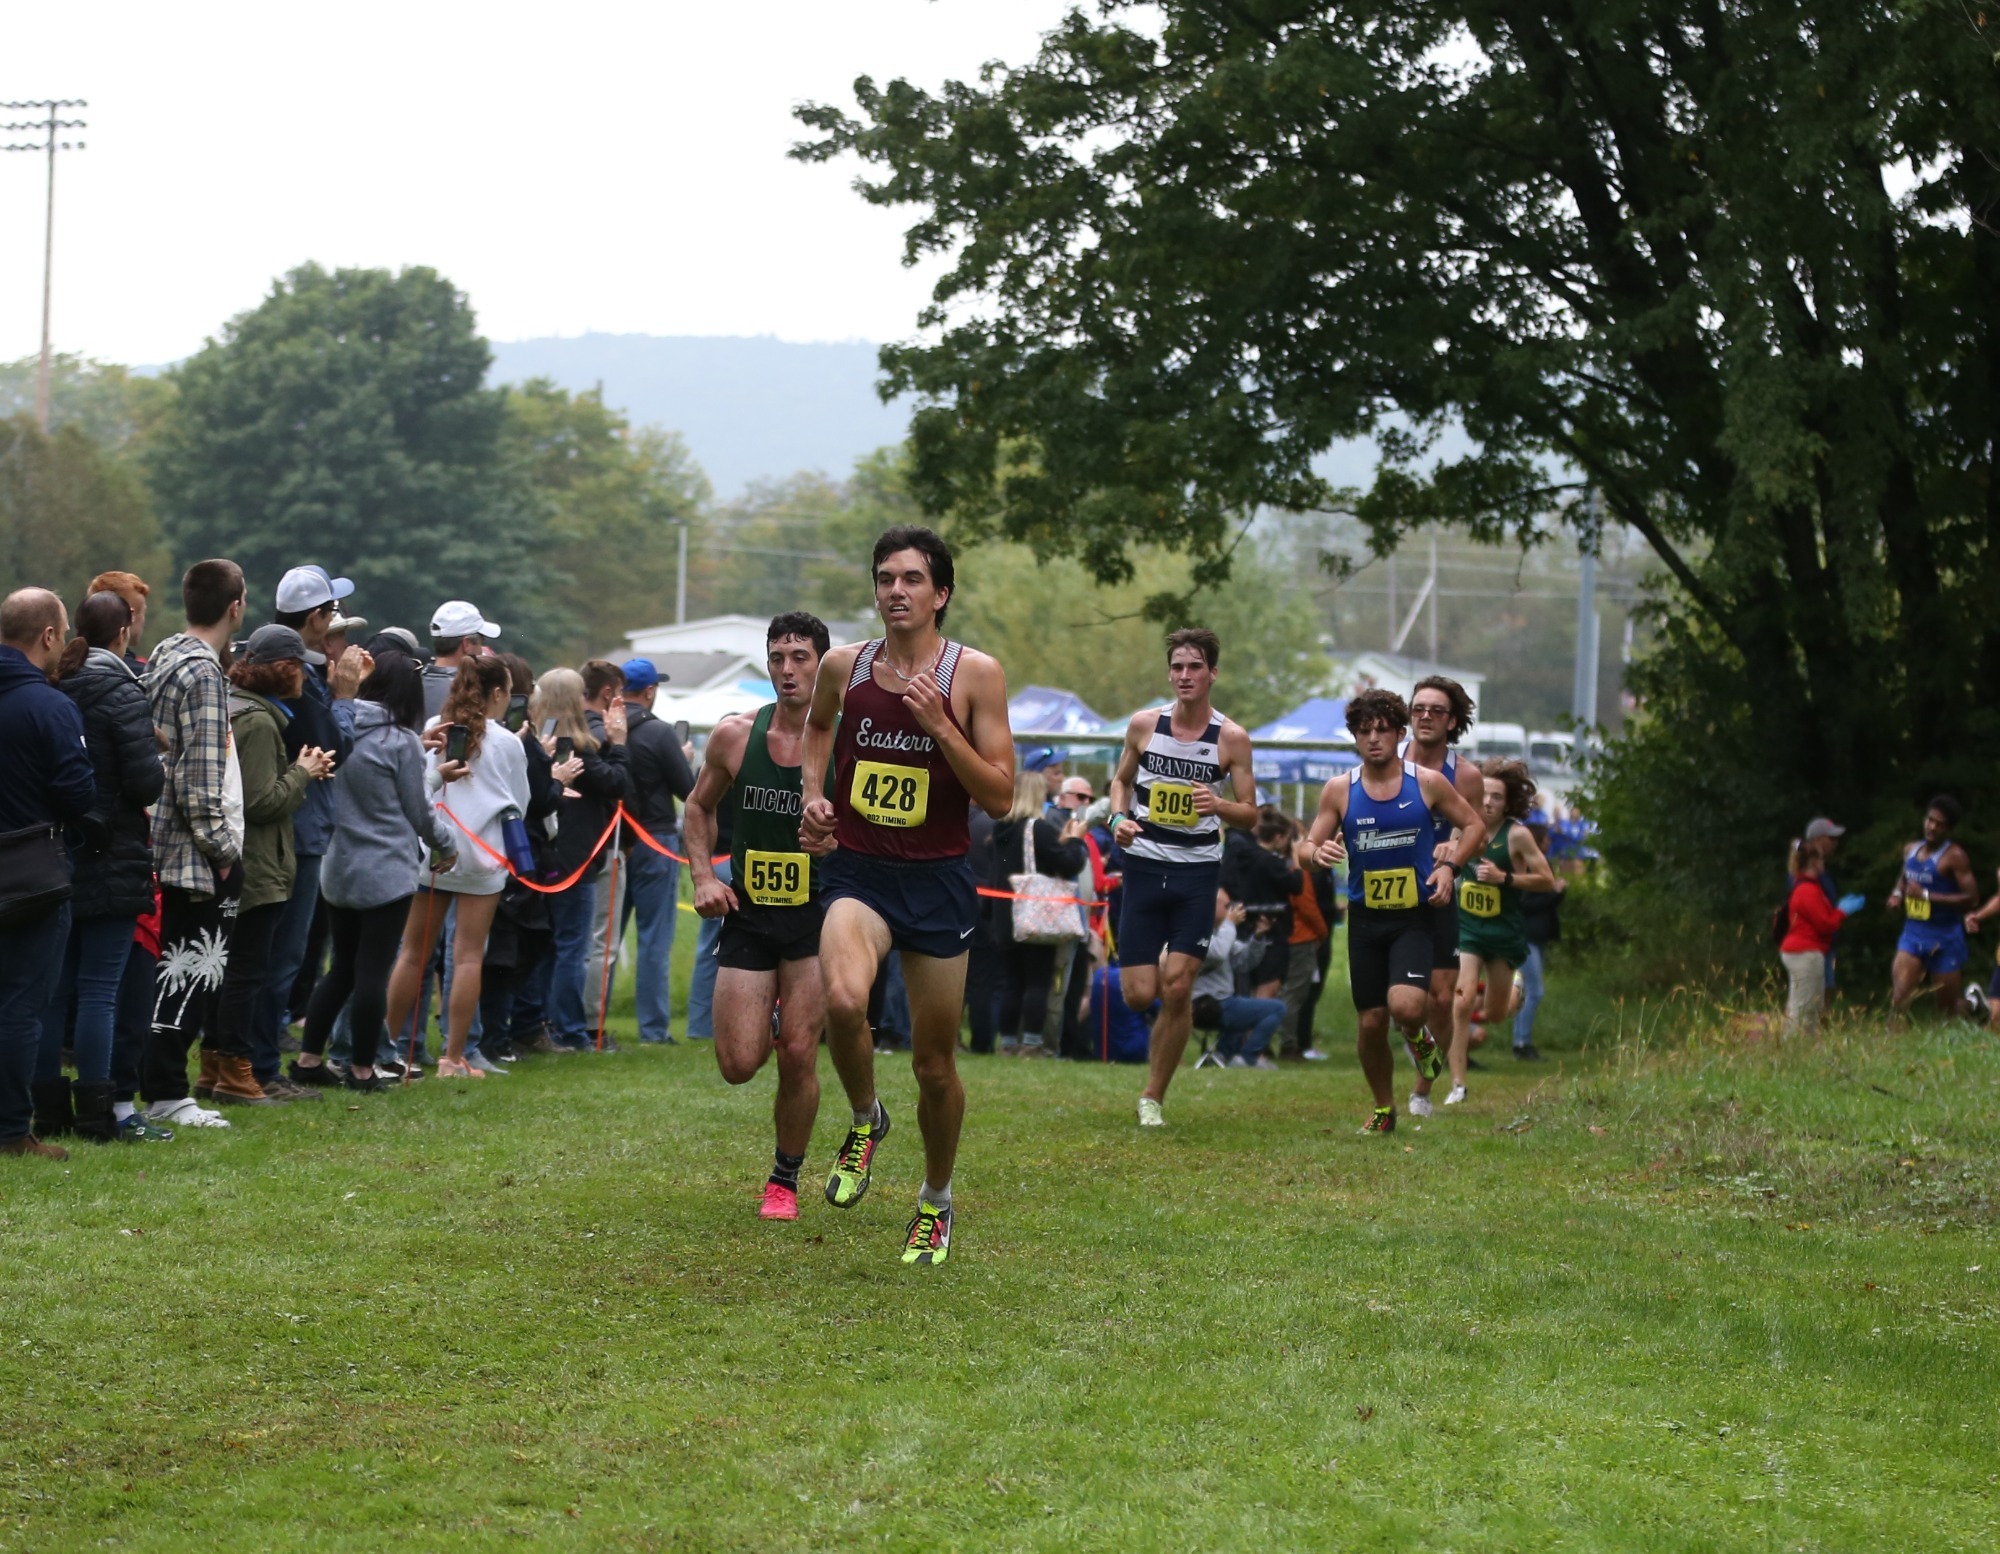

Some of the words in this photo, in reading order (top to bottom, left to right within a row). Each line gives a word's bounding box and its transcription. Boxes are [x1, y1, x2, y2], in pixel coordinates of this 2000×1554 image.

[856, 717, 934, 752] Eastern
[1147, 753, 1214, 782] BRANDEIS
[743, 785, 803, 816] NICHO
[861, 773, 917, 812] 428
[1155, 790, 1193, 816] 309
[881, 815, 907, 826] TIMING
[751, 860, 800, 892] 559
[1370, 876, 1408, 901] 277
[769, 896, 793, 904] TIMING
[1466, 891, 1495, 912] 460
